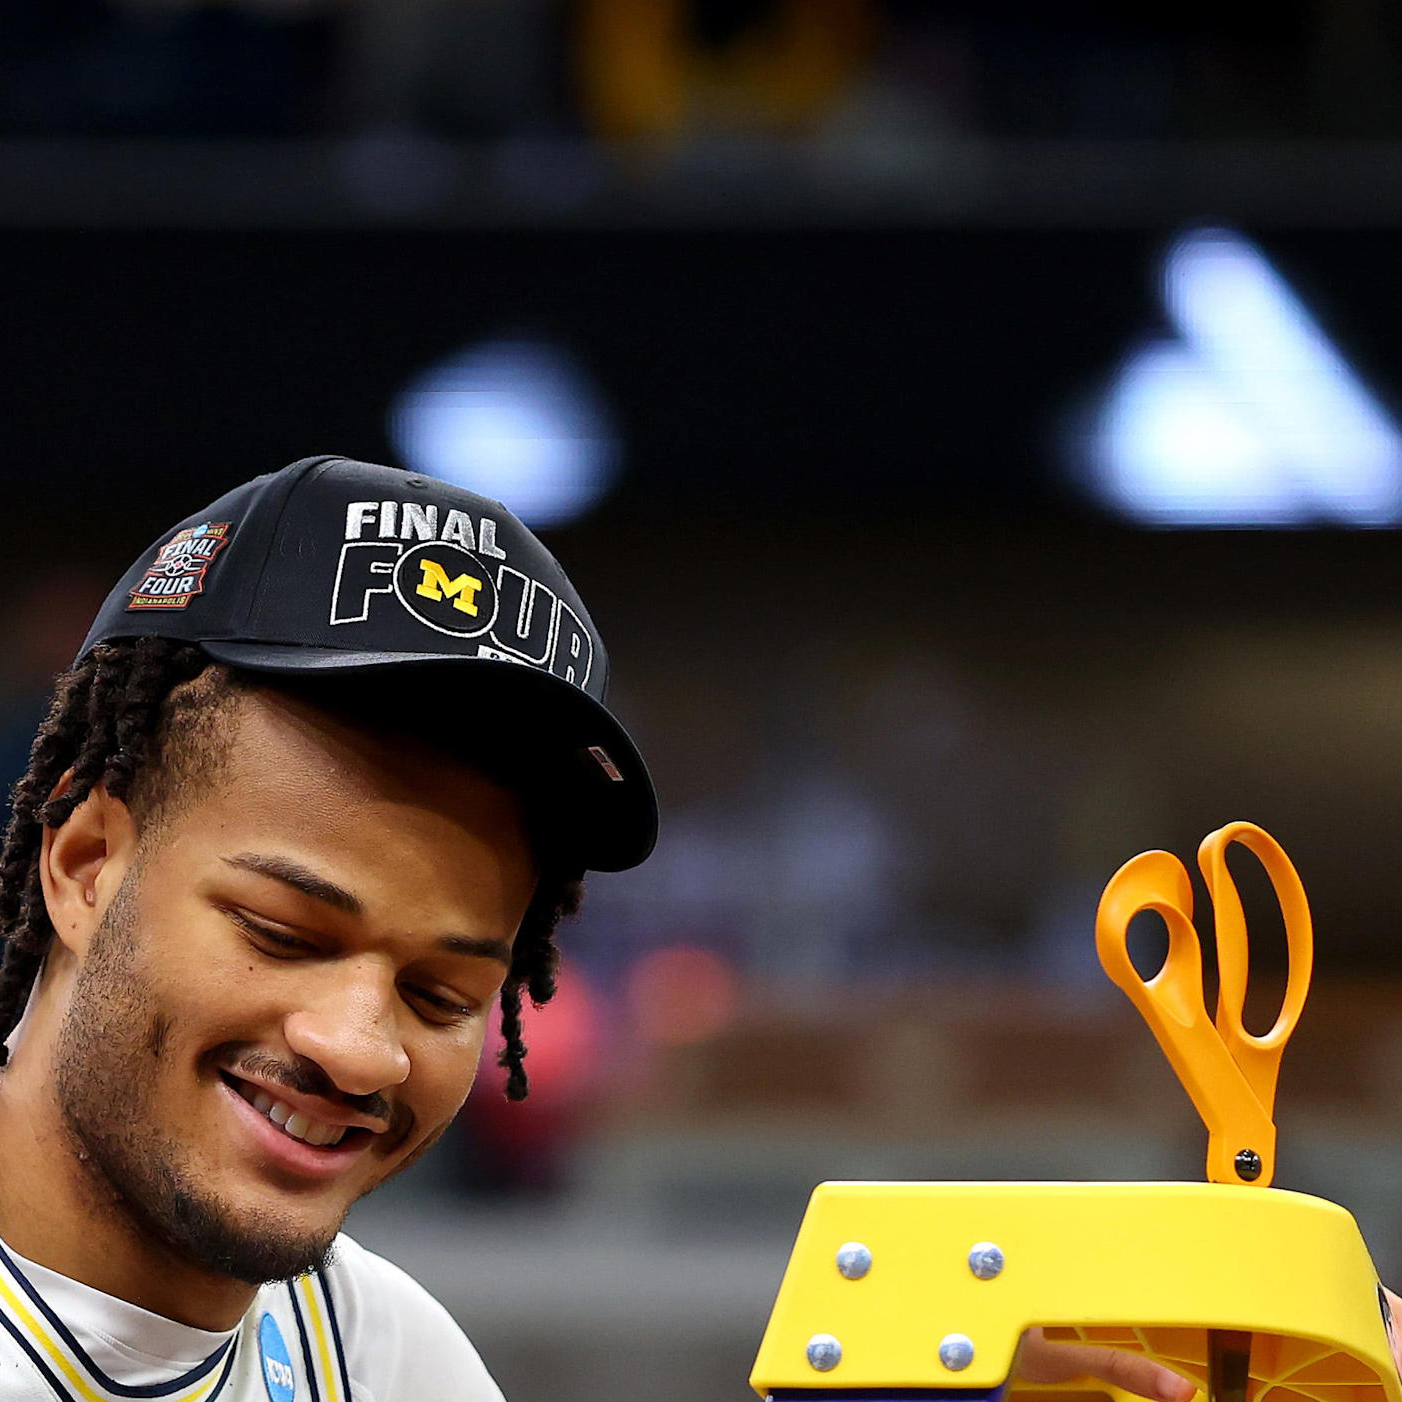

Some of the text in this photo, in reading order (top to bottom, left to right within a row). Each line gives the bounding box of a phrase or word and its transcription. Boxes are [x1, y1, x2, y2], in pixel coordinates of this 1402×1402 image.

[161, 538, 217, 560] FINAL
[345, 501, 507, 560] FINAL
[138, 576, 195, 595] FOUR
[416, 558, 483, 618] M
[329, 541, 593, 691] FOUR
